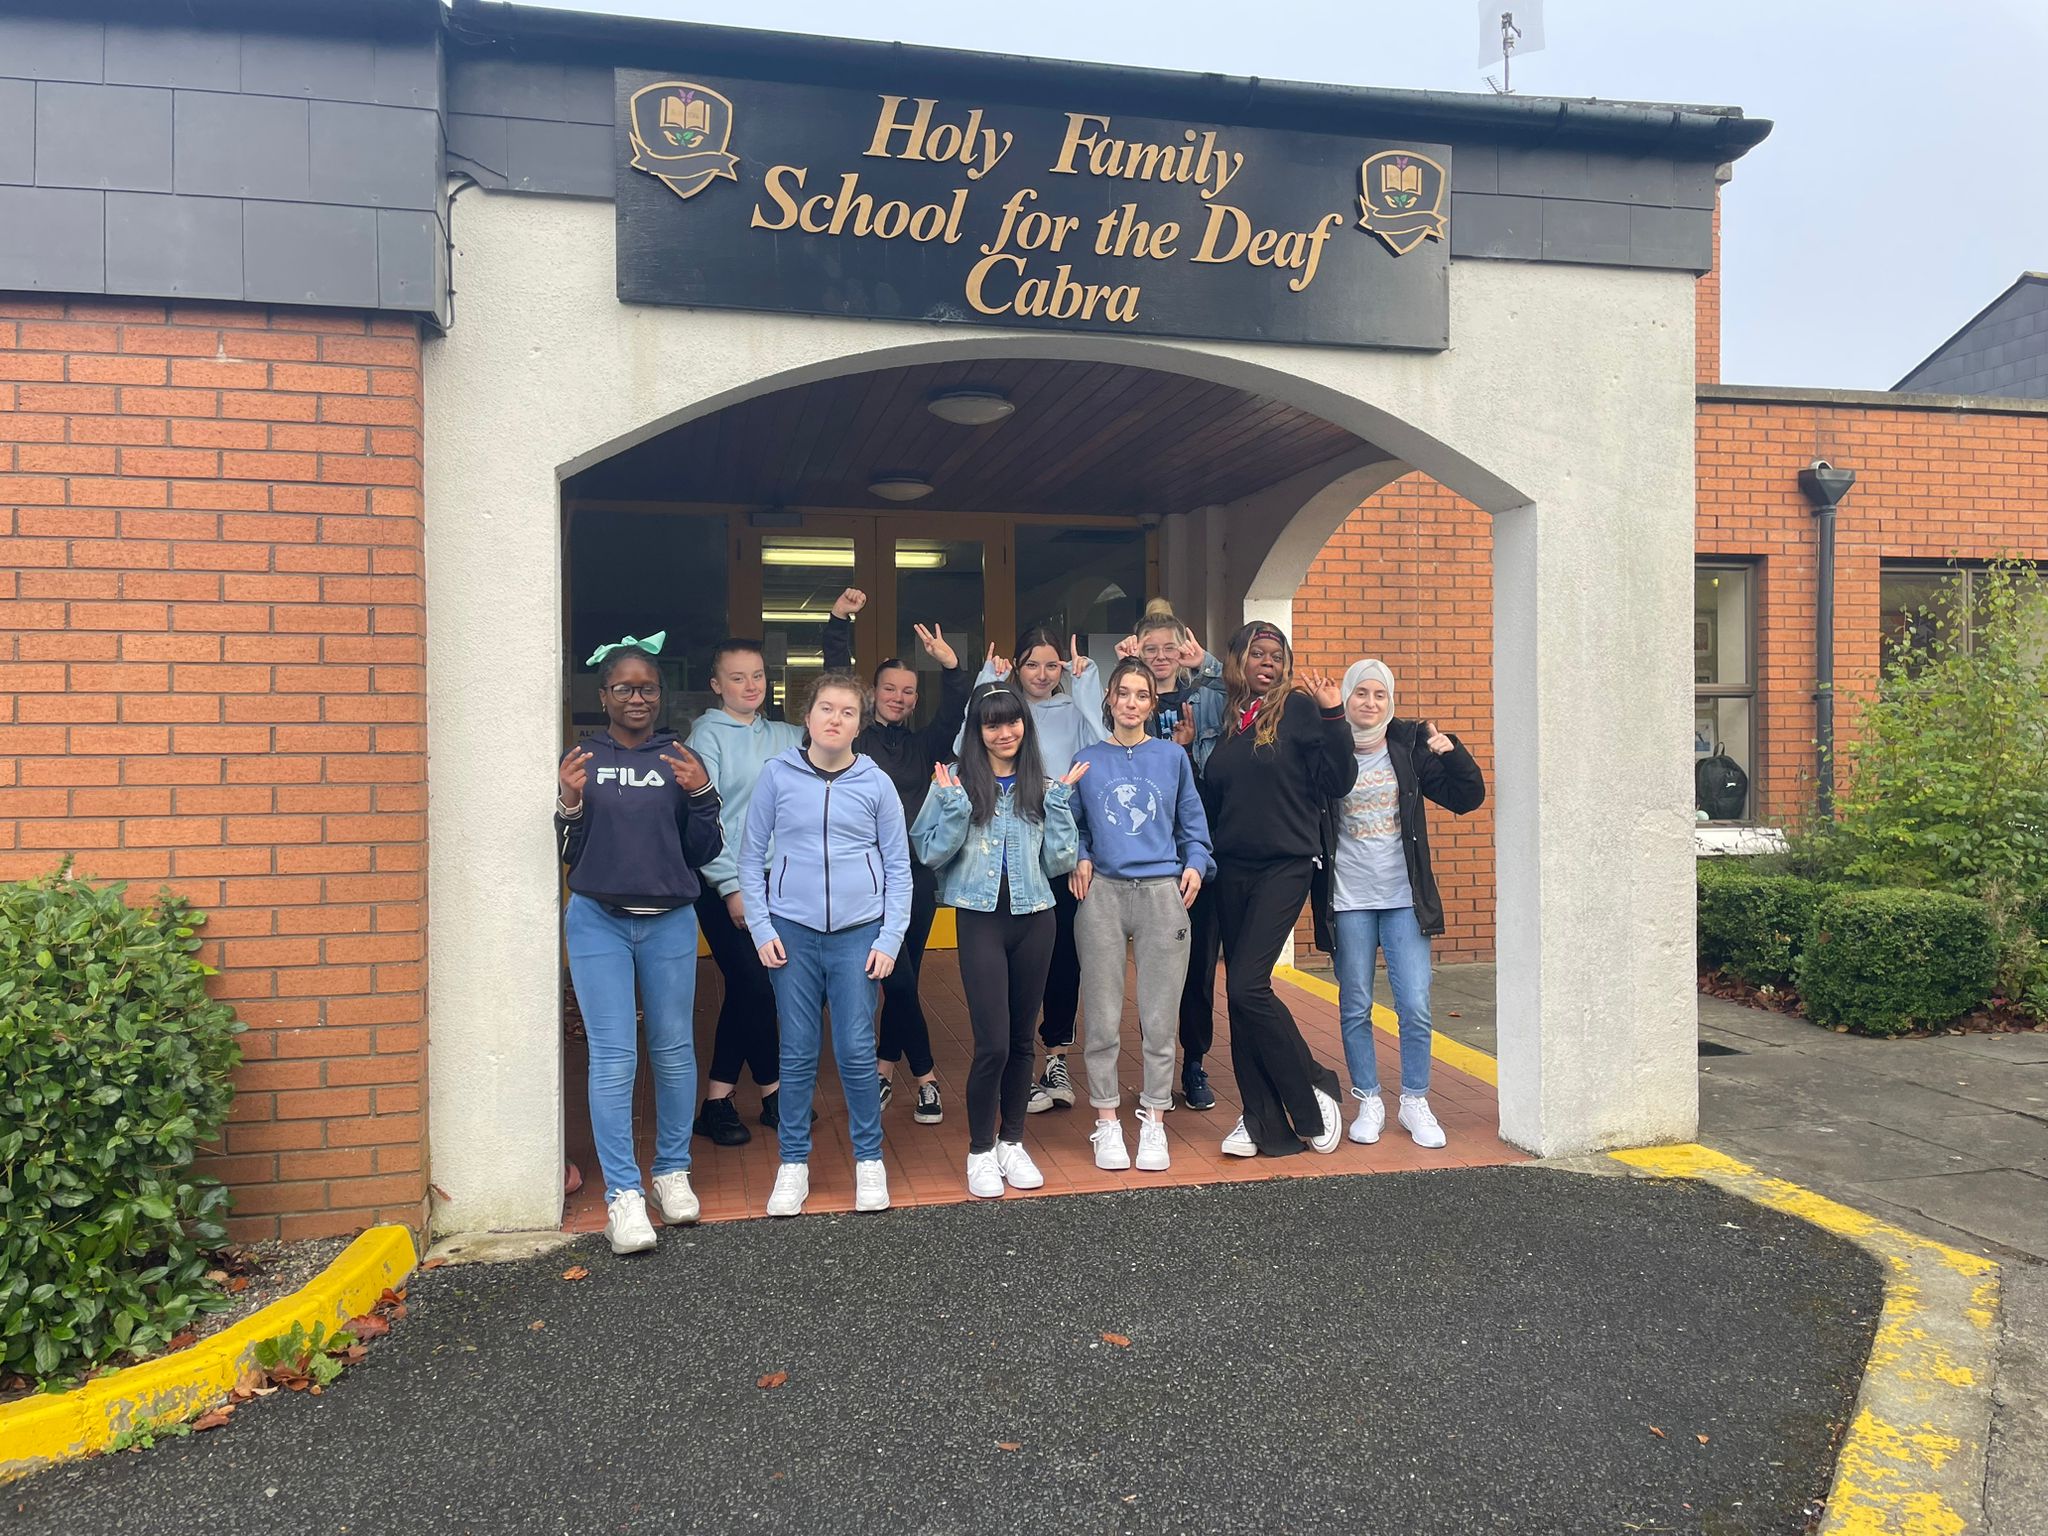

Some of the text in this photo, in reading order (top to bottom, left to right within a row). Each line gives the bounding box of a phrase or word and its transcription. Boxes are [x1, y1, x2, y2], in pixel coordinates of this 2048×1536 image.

[862, 95, 1244, 199] Holy Family
[751, 165, 1343, 292] School for the Deaf
[965, 254, 1141, 323] Cabra
[596, 767, 665, 787] FILA
